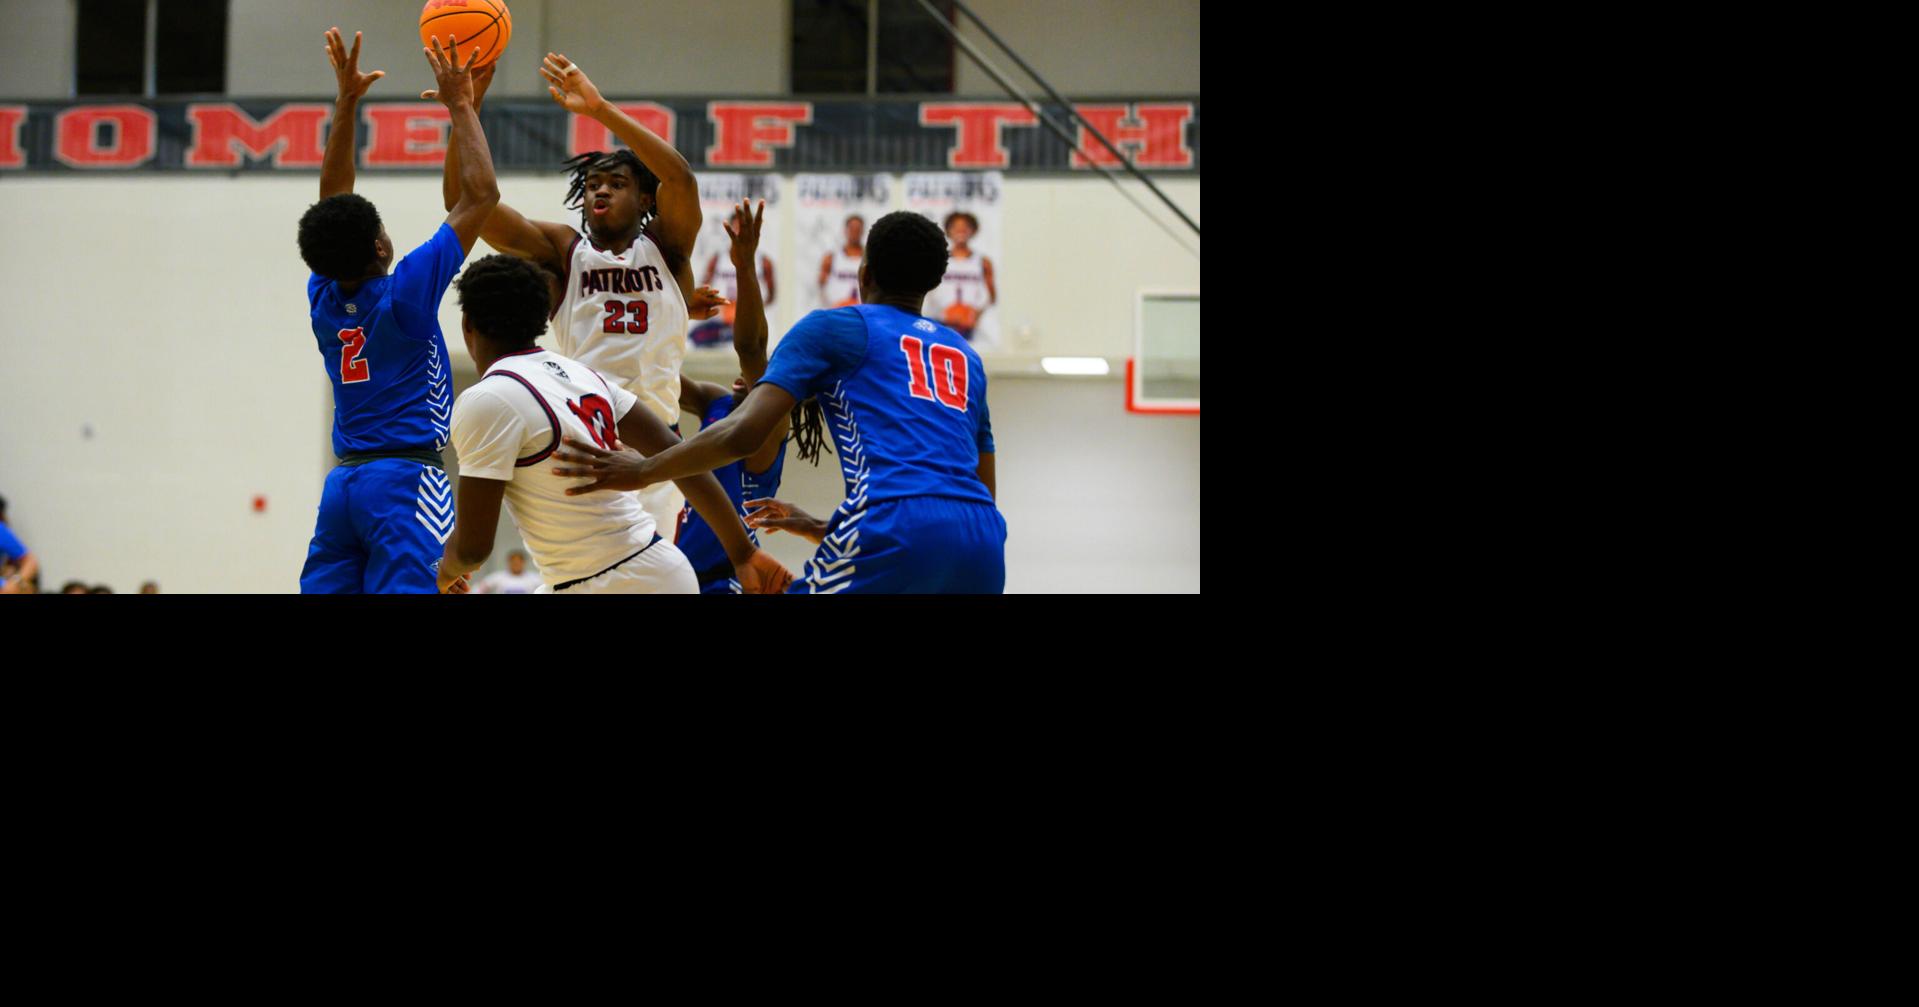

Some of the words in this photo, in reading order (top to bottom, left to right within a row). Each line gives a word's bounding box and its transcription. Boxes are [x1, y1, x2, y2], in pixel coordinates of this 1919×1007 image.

[0, 103, 453, 169] OME
[581, 265, 663, 297] PATRIOTS
[603, 300, 649, 334] 23
[337, 326, 370, 384] 2
[900, 334, 969, 413] 10
